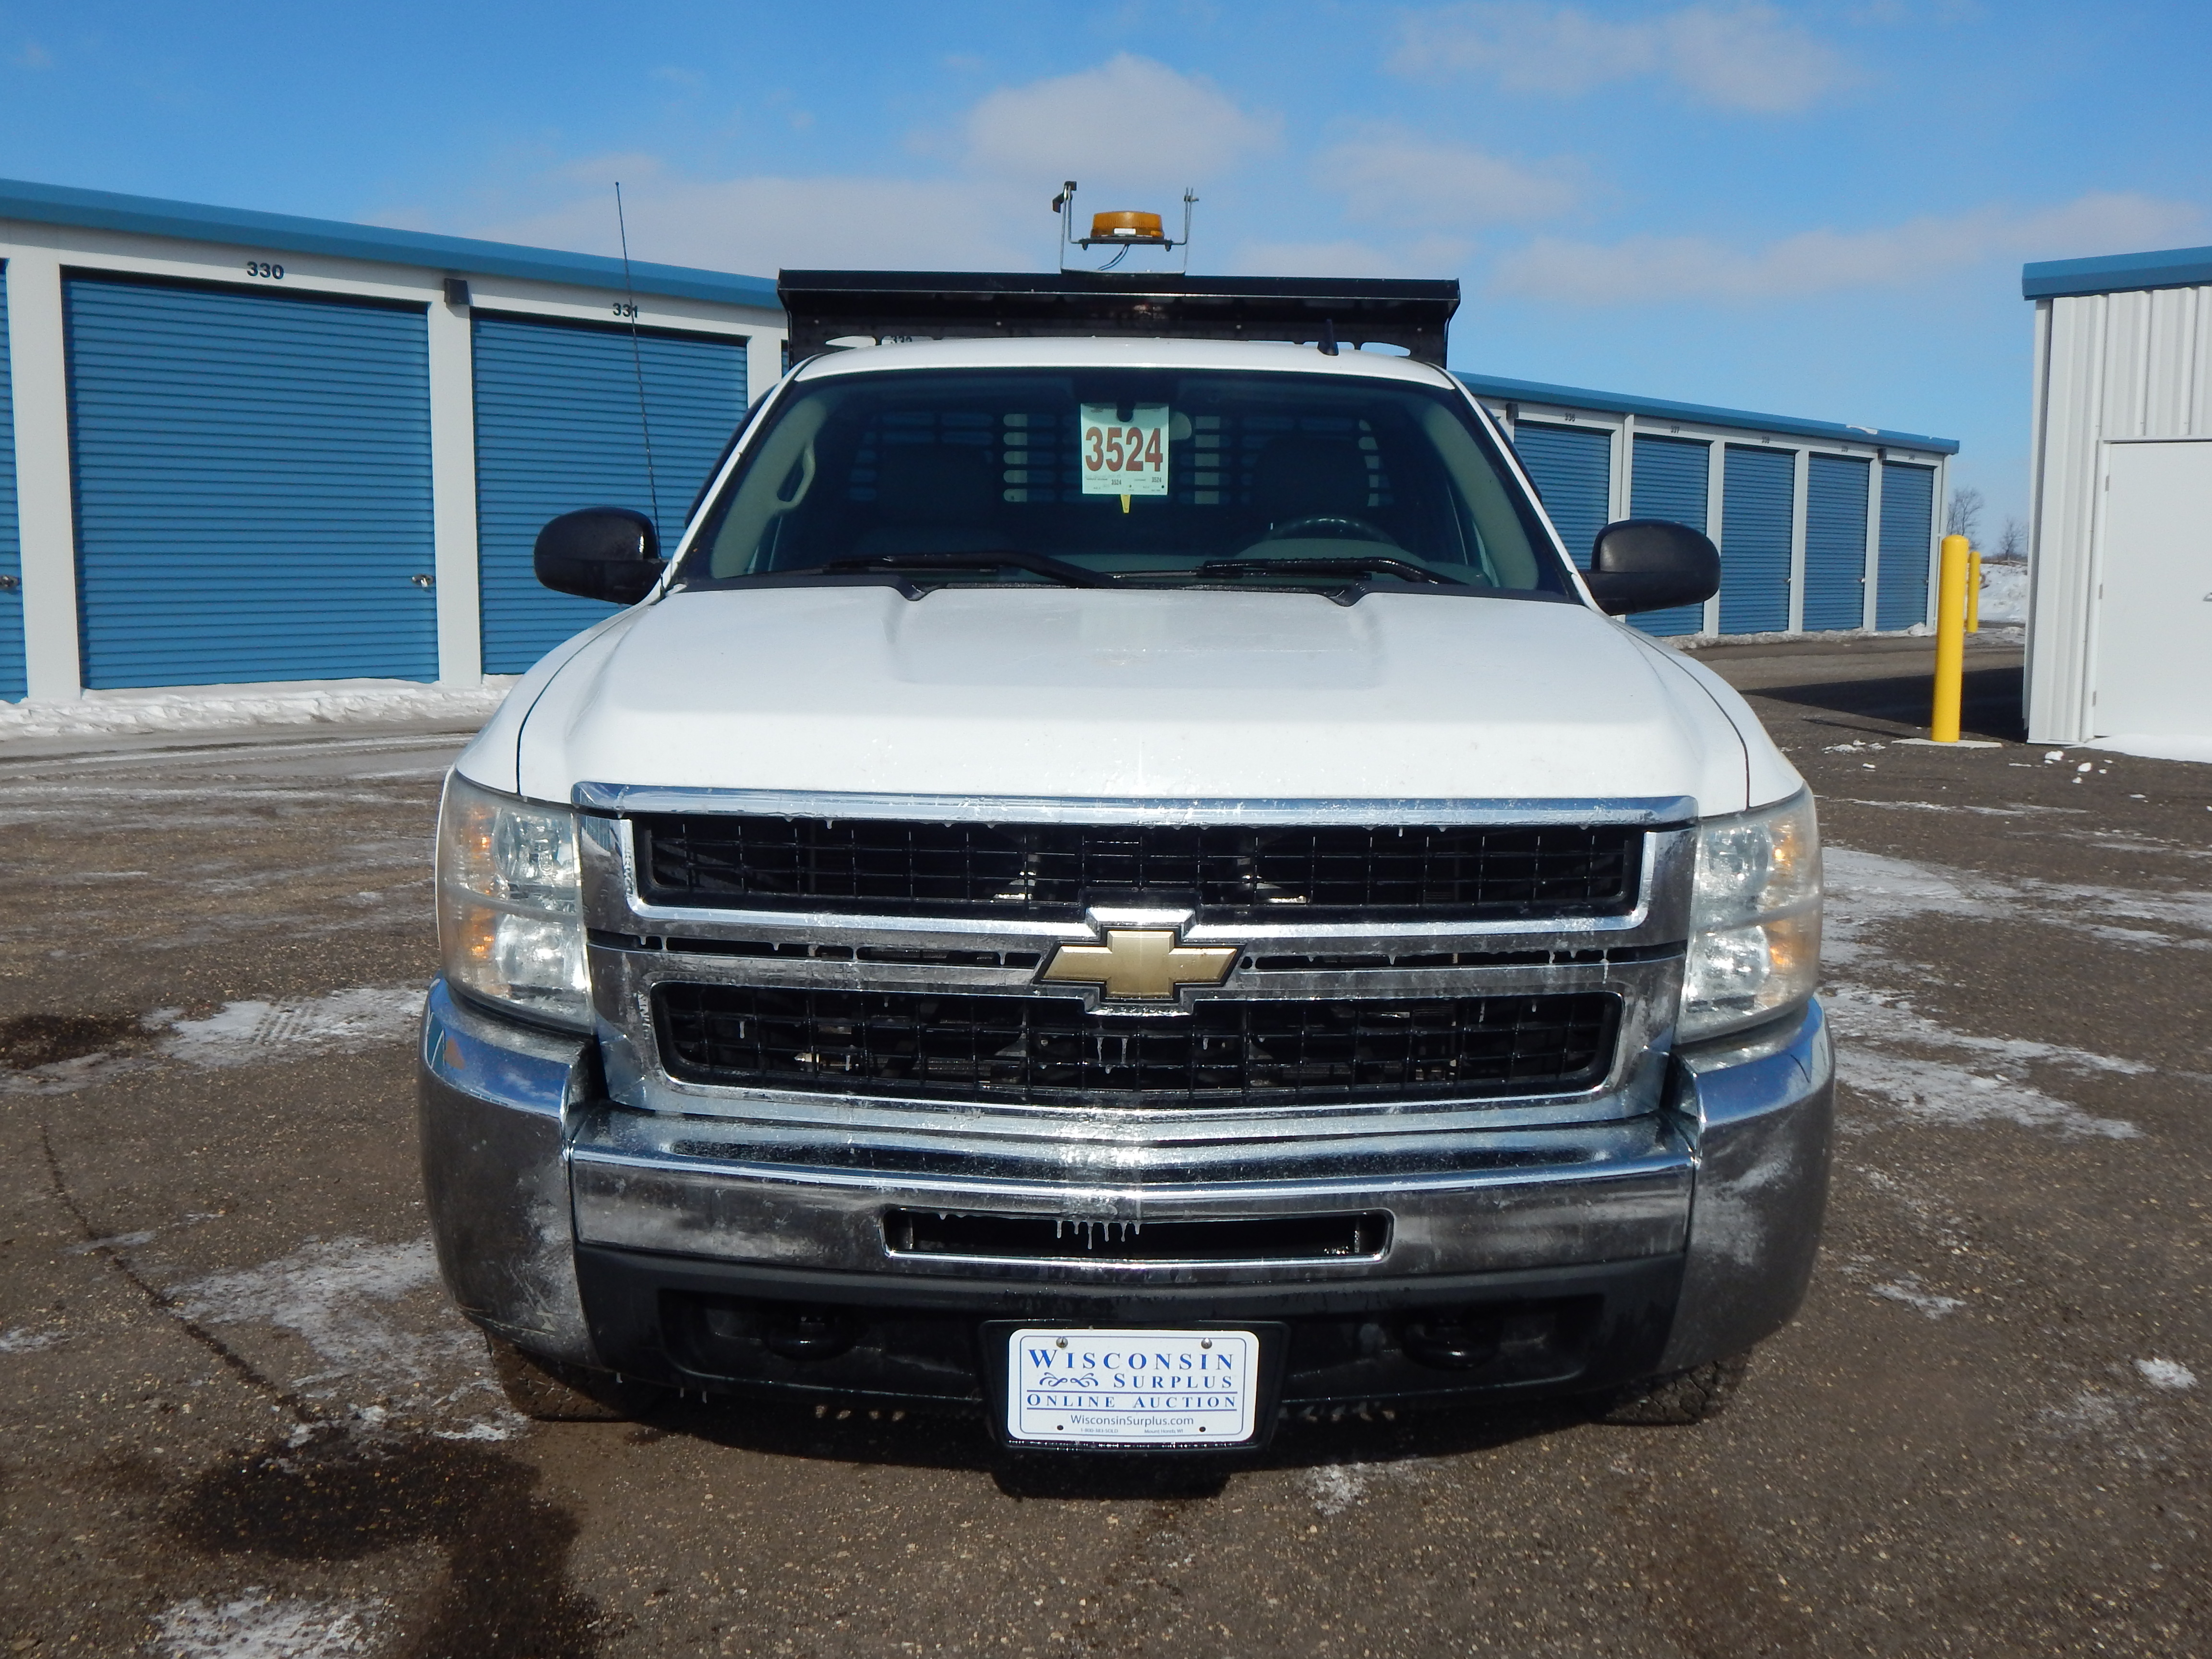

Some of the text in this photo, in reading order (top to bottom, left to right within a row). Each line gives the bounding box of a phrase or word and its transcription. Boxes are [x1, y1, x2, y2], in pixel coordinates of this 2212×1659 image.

[247, 261, 284, 279] 330
[613, 302, 638, 318] 331
[1085, 426, 1164, 472] 3524
[1028, 1349, 1234, 1370] WISCONSIN
[1113, 1372, 1232, 1389] SURPLUS
[1027, 1394, 1235, 1408] ONLINE AUCTION
[1070, 1415, 1194, 1428] WisconsinSurplus.com
